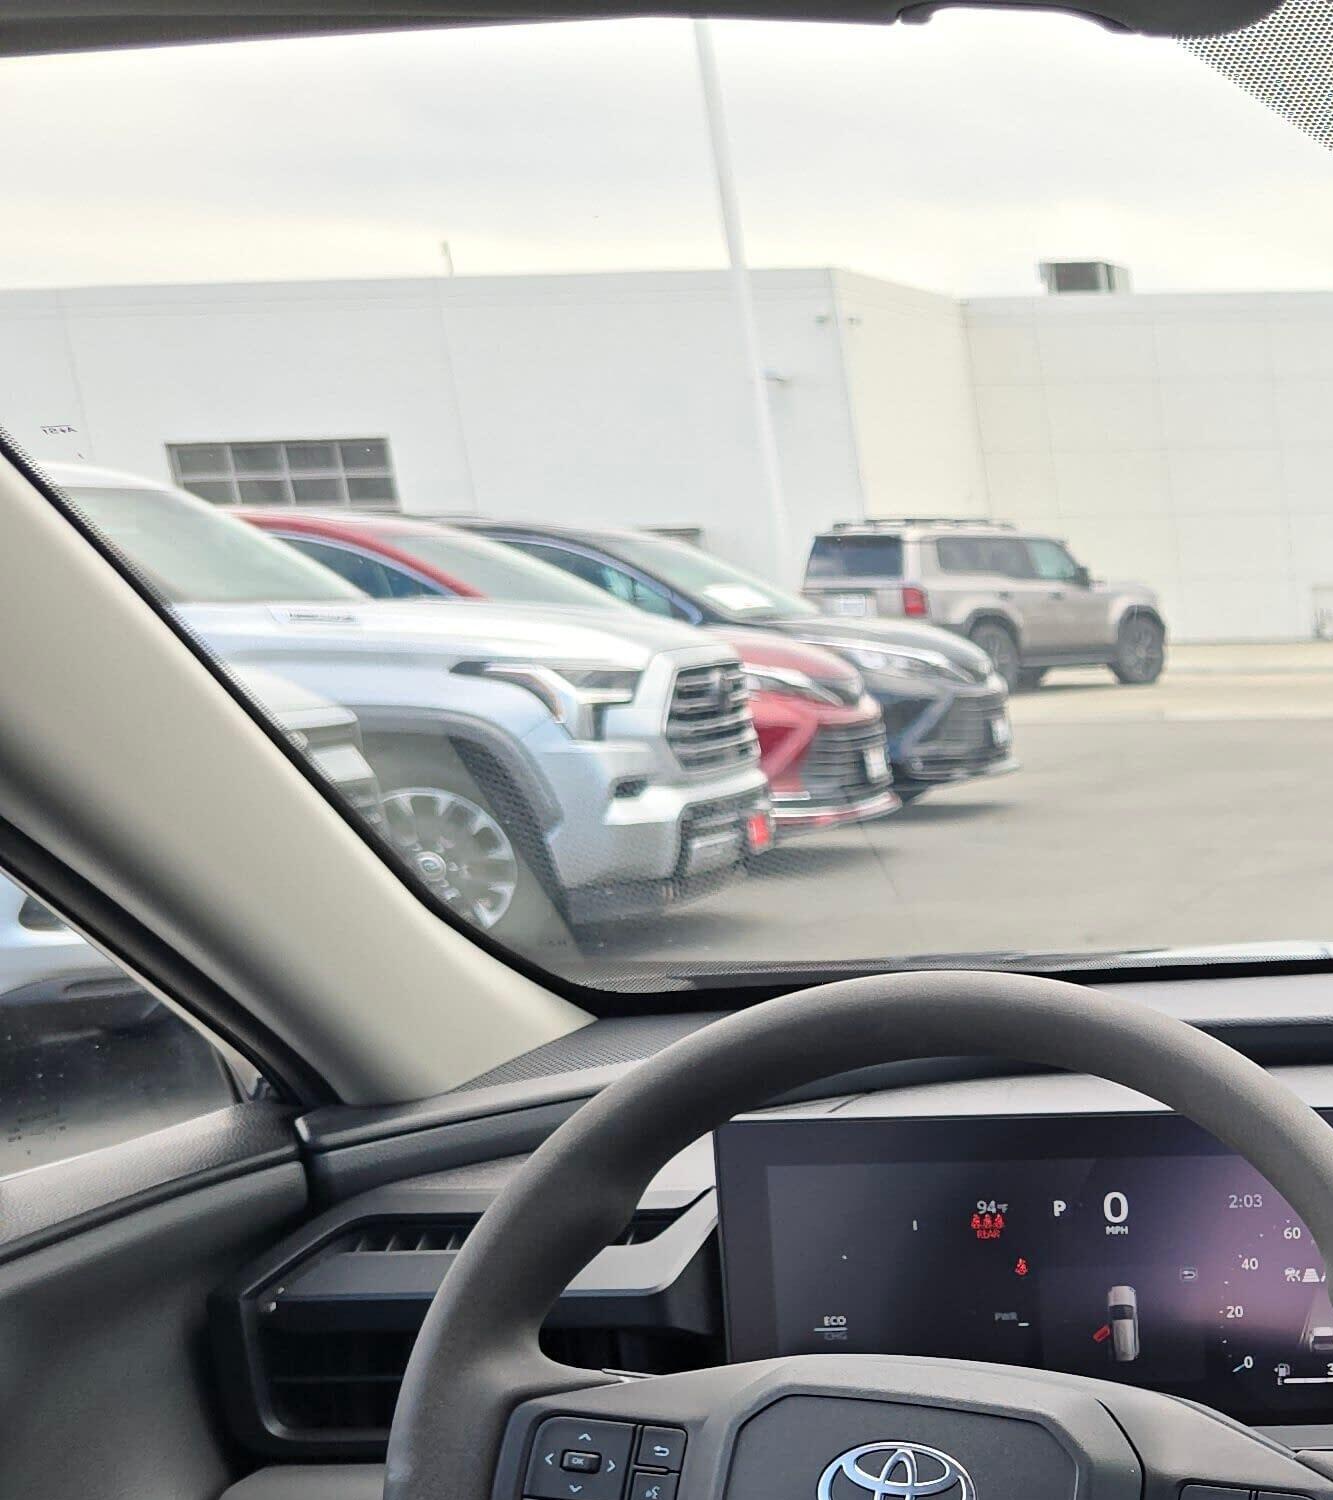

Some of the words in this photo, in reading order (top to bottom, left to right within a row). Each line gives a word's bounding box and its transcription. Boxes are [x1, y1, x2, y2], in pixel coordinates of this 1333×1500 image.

[1053, 1200, 1067, 1217] P
[1103, 1191, 1129, 1224] 0
[1228, 1194, 1263, 1209] 2:03
[1105, 1226, 1129, 1236] MPH
[1283, 1227, 1301, 1240] 60
[1241, 1257, 1259, 1271] 40
[1226, 1305, 1244, 1319] 20
[823, 1315, 848, 1327] ECO
[1243, 1355, 1254, 1369] 0
